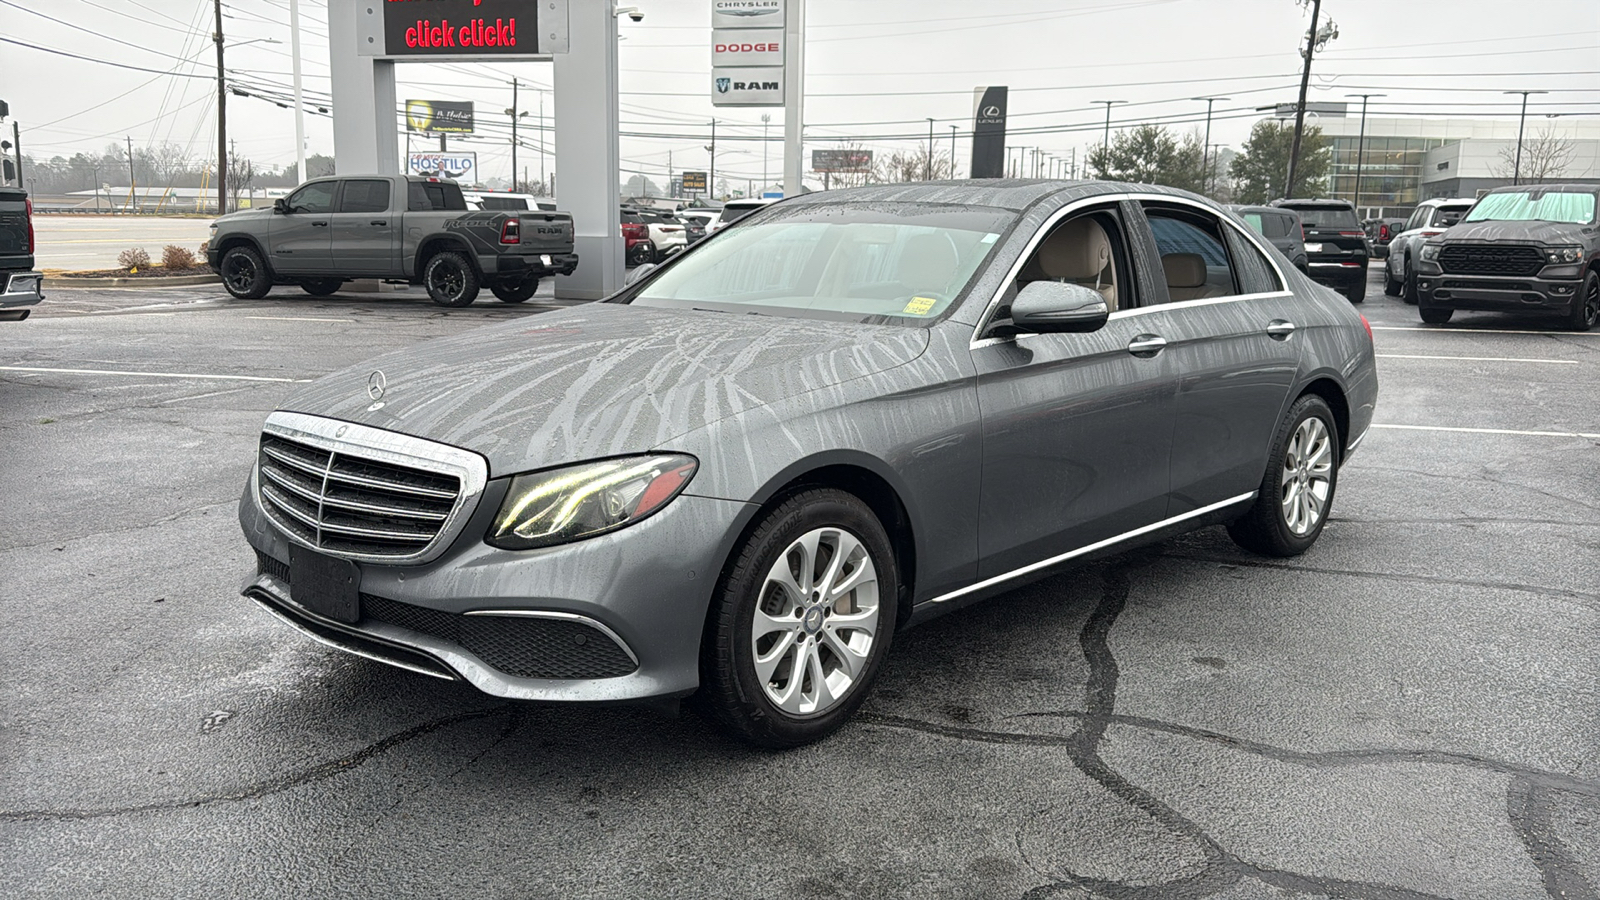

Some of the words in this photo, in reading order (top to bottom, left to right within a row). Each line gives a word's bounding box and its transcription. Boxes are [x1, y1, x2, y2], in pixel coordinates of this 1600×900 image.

[405, 20, 455, 48] click
[459, 18, 516, 47] click!
[715, 43, 779, 53] DODGE
[733, 82, 779, 90] RAM
[410, 158, 472, 170] HOSTILO
[537, 227, 562, 235] RAM
